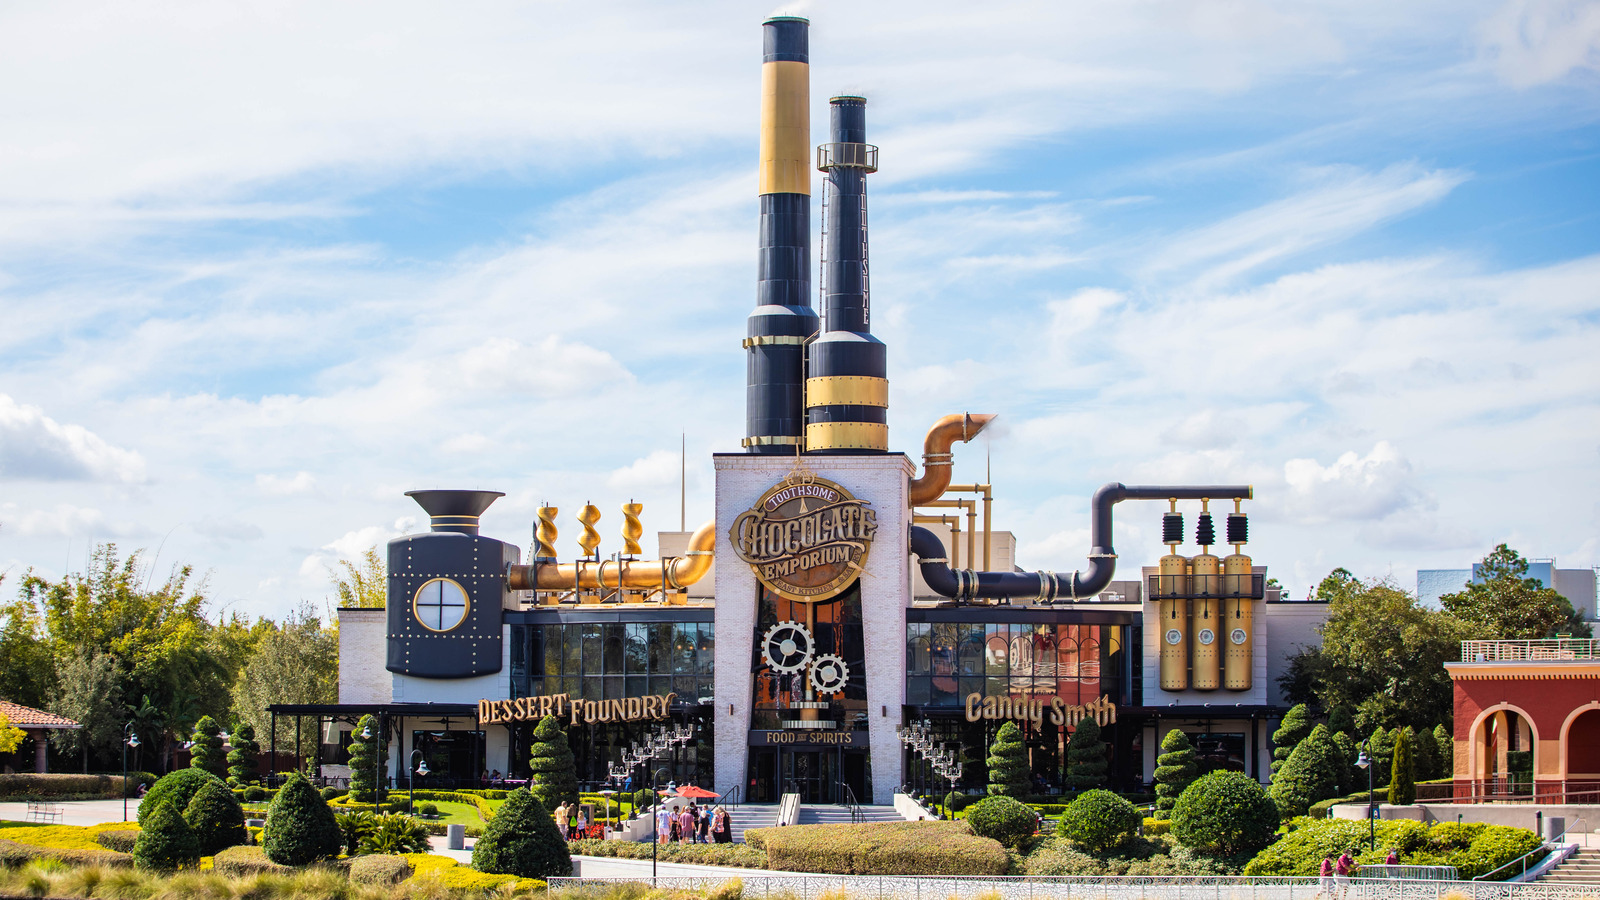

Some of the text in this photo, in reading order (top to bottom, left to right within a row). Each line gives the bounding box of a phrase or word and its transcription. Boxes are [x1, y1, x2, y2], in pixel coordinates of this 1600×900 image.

[860, 177, 869, 325] TOOTHSOME
[768, 485, 836, 507] TOOTHSOME
[728, 504, 878, 565] CHOCOLATE
[763, 545, 851, 582] EMPORIUM
[798, 582, 834, 595] KITCHEN
[478, 692, 679, 727] DESSERT FOUNDRY
[965, 689, 1117, 732] Candy Smith
[766, 732, 795, 743] FOOD
[809, 732, 852, 744] SPIRITS
